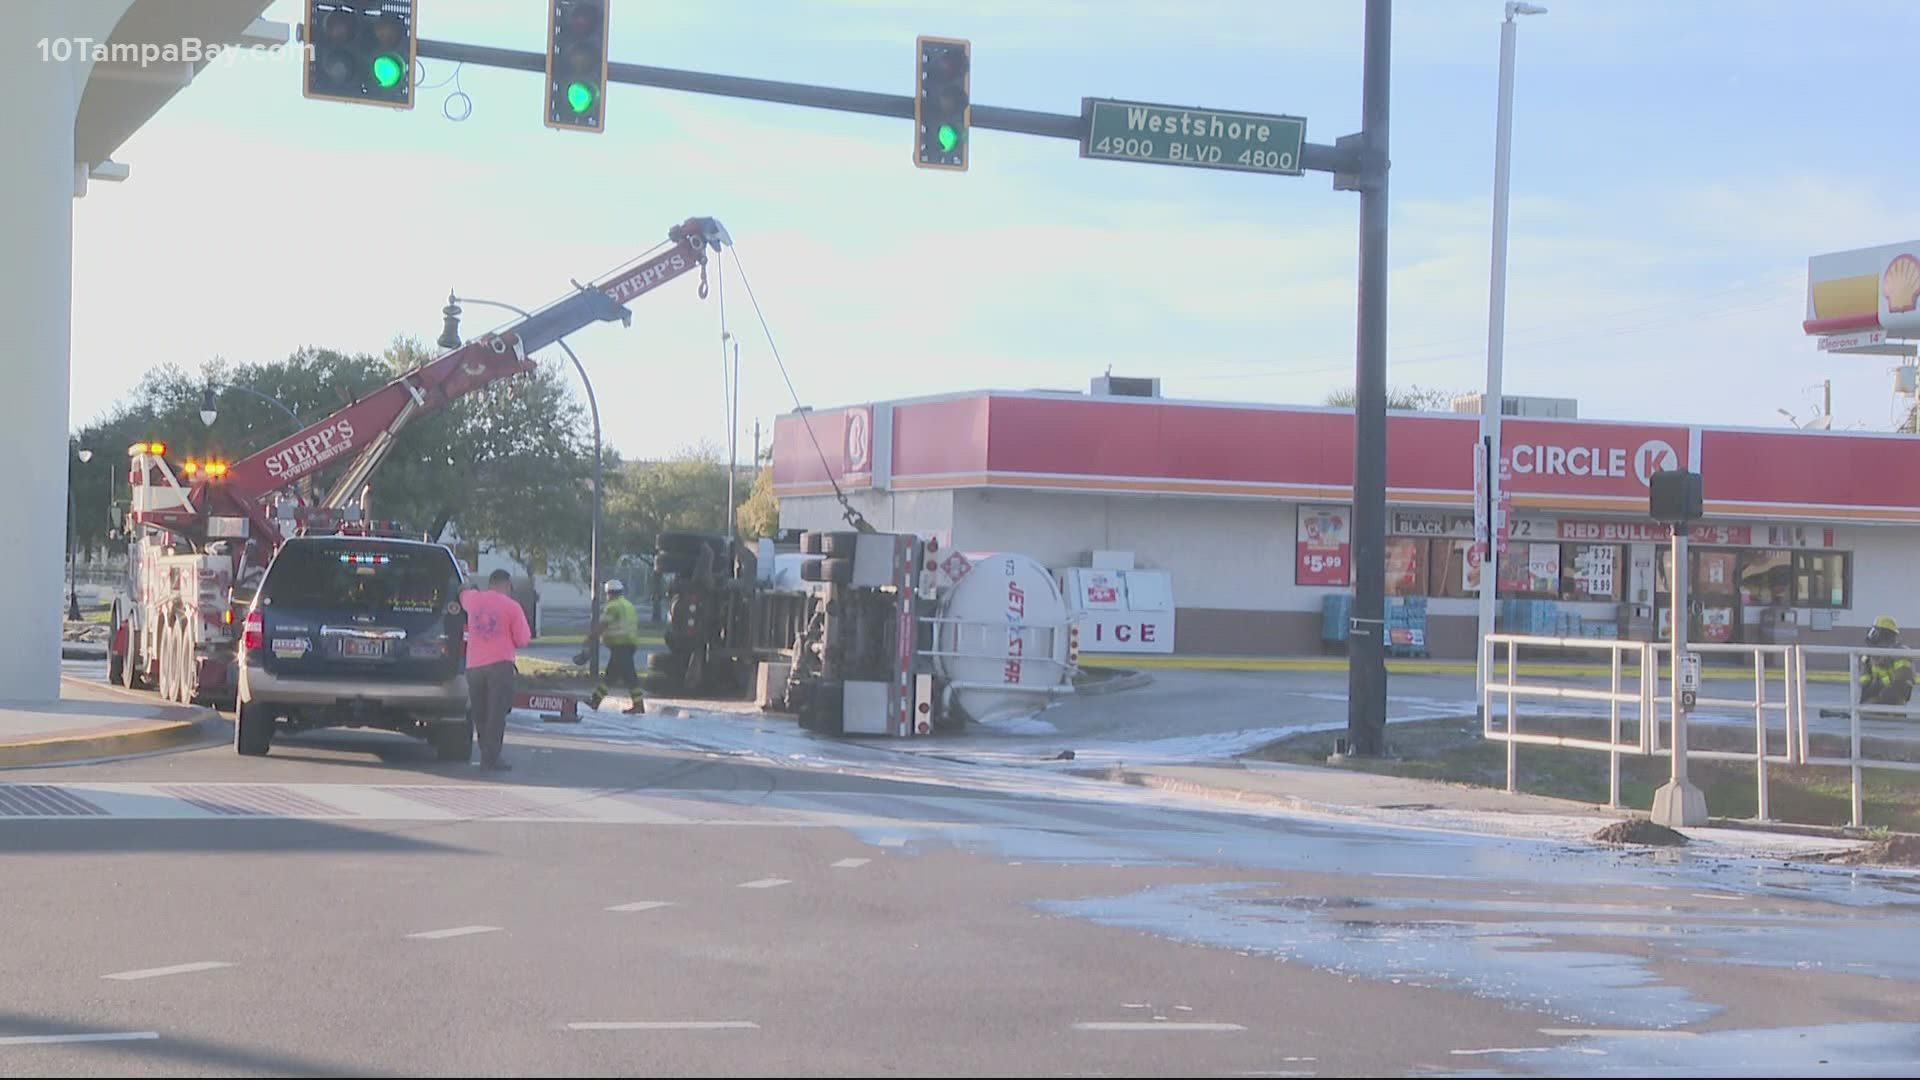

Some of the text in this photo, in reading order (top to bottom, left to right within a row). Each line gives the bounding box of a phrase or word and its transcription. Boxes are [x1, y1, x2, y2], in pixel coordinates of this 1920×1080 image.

[1127, 107, 1271, 143] Westshore
[1096, 136, 1292, 169] 4900 BLVD 4800
[265, 419, 354, 477] STEPP'S
[280, 438, 353, 480] TOWING SERVICE
[1512, 444, 1627, 478] CIRCLE
[1400, 520, 1443, 534] BLACK
[1563, 523, 1600, 538] RED
[1604, 524, 1651, 539] BULL
[1008, 581, 1024, 618] JET
[1096, 623, 1155, 642] ICE
[529, 695, 563, 709] CAUTION
